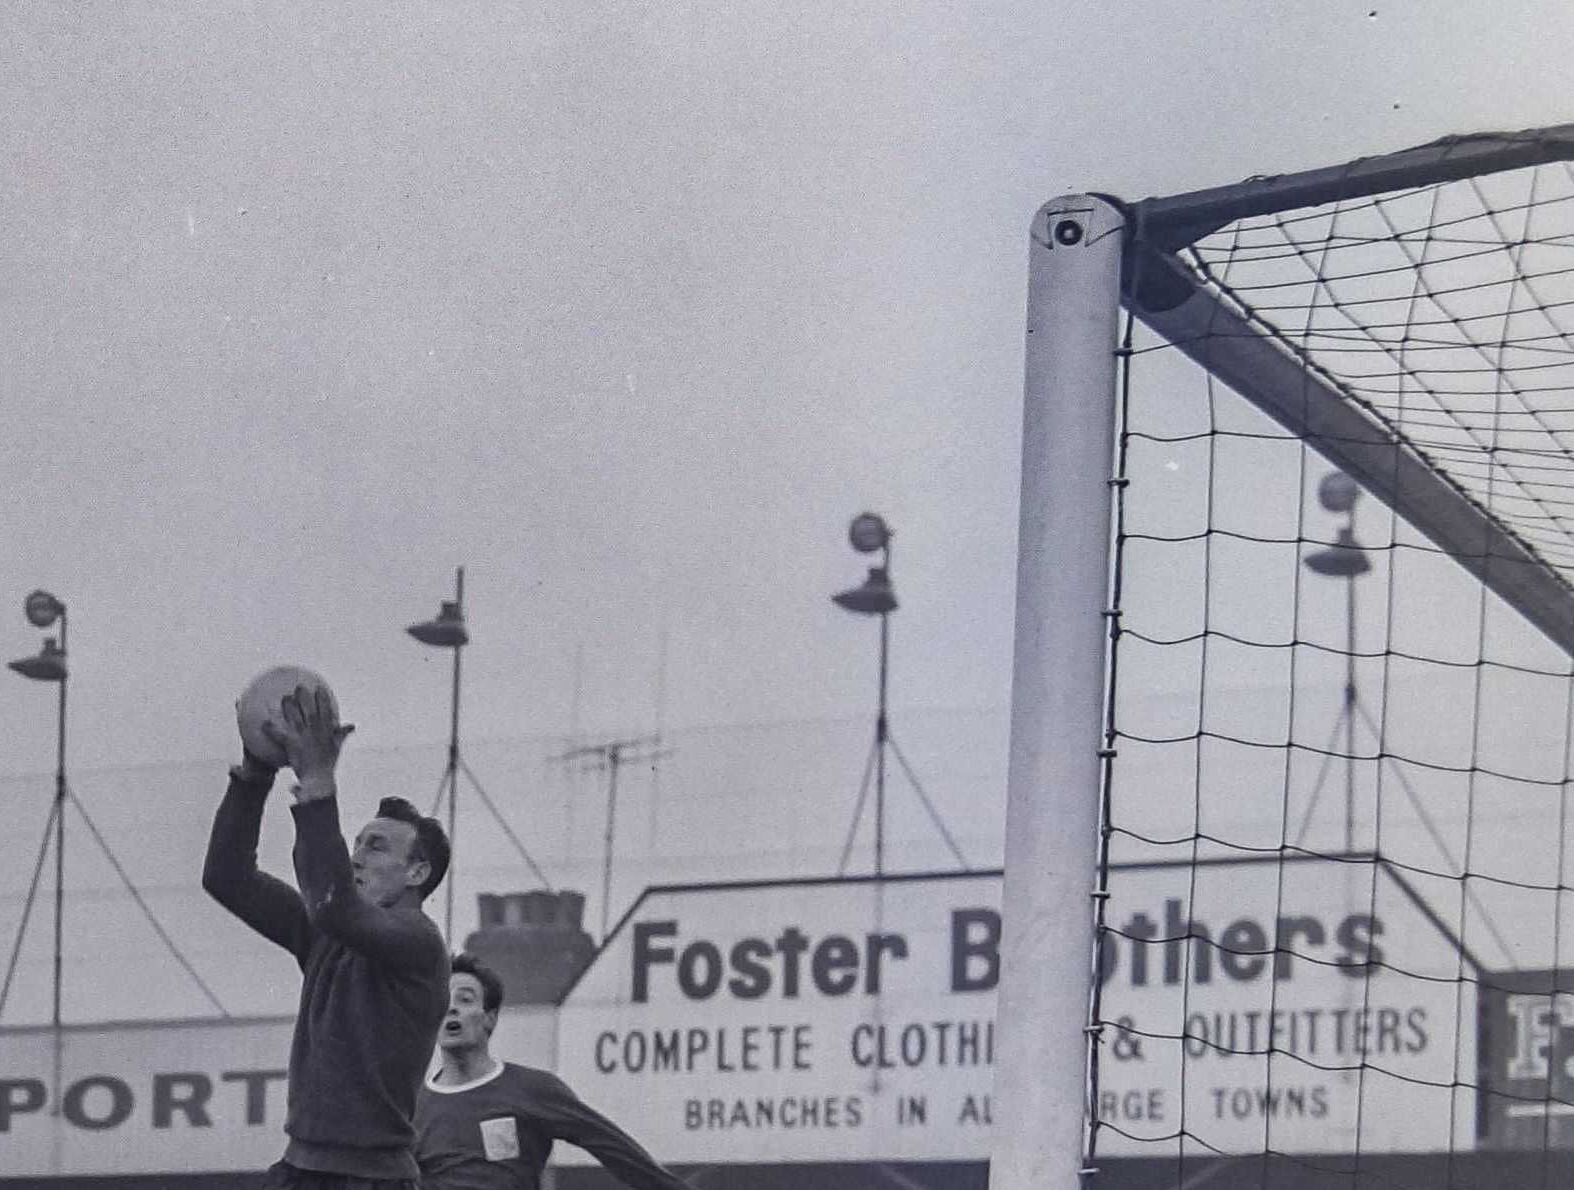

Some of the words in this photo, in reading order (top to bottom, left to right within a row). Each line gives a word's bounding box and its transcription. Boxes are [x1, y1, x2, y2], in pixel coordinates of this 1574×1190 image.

[631, 920, 910, 1003] Foster
[950, 898, 1385, 990] Bthers
[594, 1023, 814, 1075] COMPLETE
[851, 1021, 995, 1069] CLOTHI
[1112, 1014, 1144, 1061] &
[1184, 1006, 1430, 1059] OUTFITTERS
[683, 1095, 863, 1132] BRANCHES
[895, 1096, 928, 1127] IN
[957, 1094, 994, 1127] AL
[1099, 1087, 1165, 1121] RGE
[1210, 1086, 1330, 1120] TOWNS
